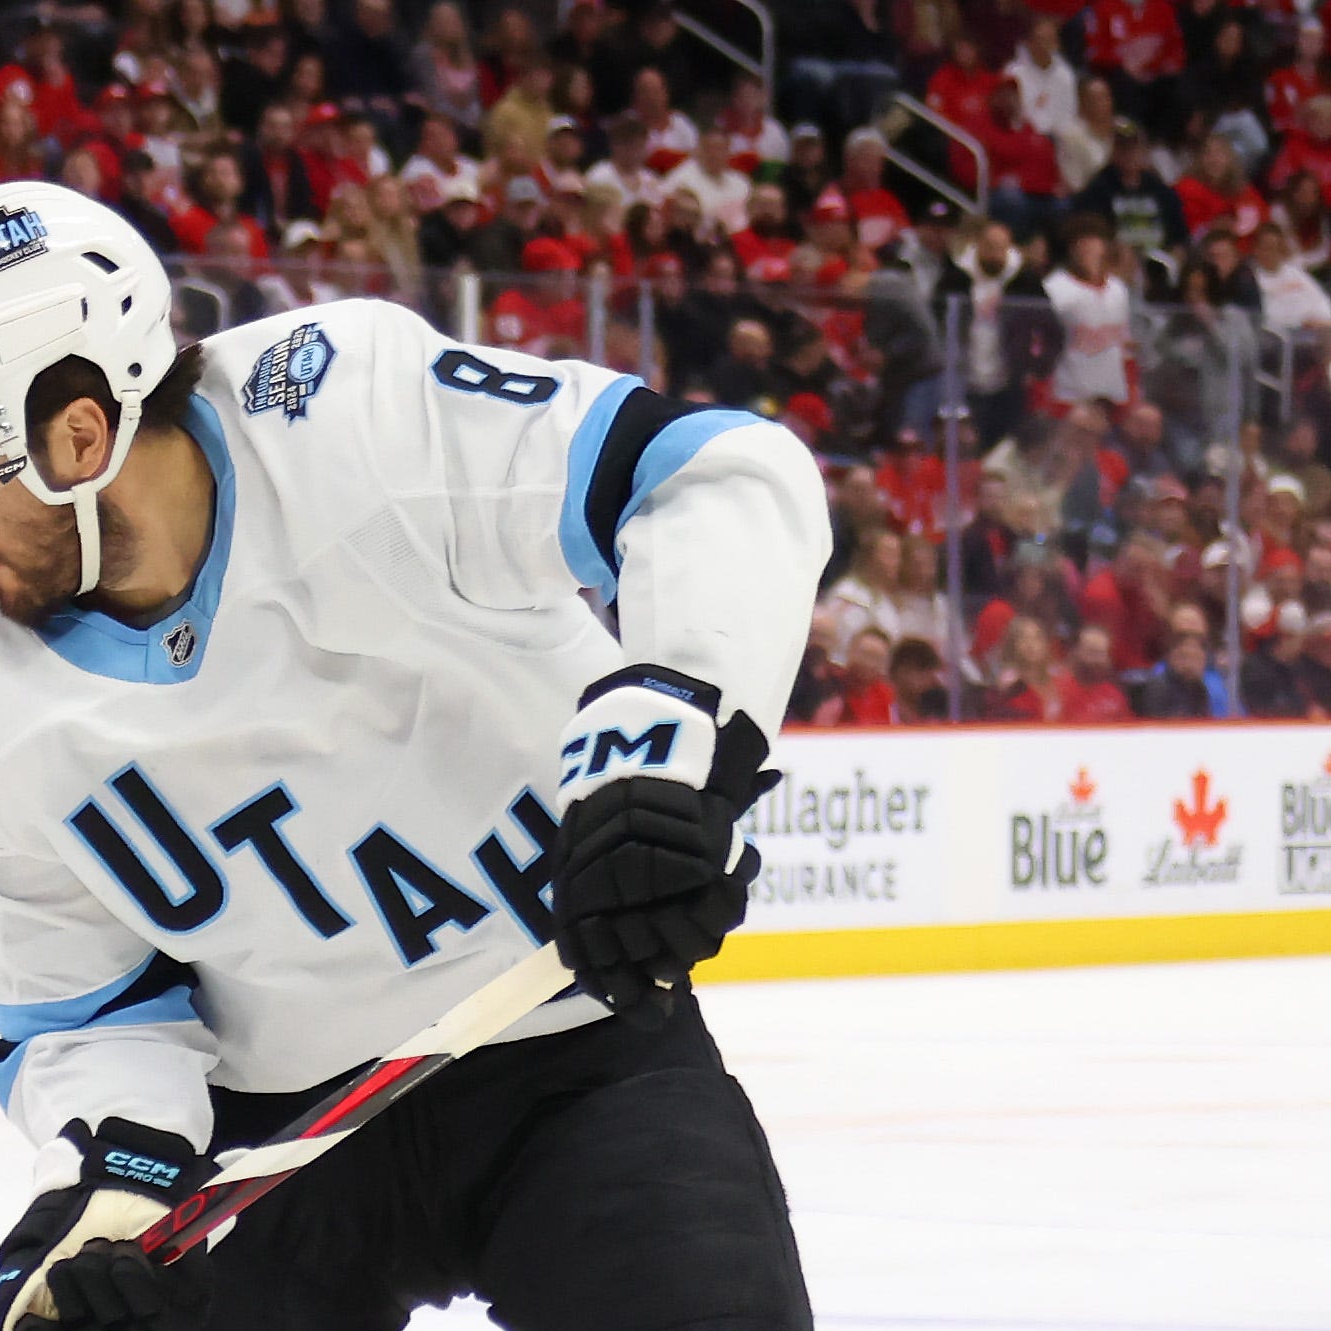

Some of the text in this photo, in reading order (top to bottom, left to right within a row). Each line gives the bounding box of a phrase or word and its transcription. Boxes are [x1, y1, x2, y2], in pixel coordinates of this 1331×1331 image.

[267, 340, 291, 406] SEASON
[300, 347, 315, 378] UTAH
[429, 348, 562, 408] 8
[62, 759, 563, 969] UTAH
[1010, 812, 1108, 888] Blue
[103, 1150, 182, 1180] CCM
